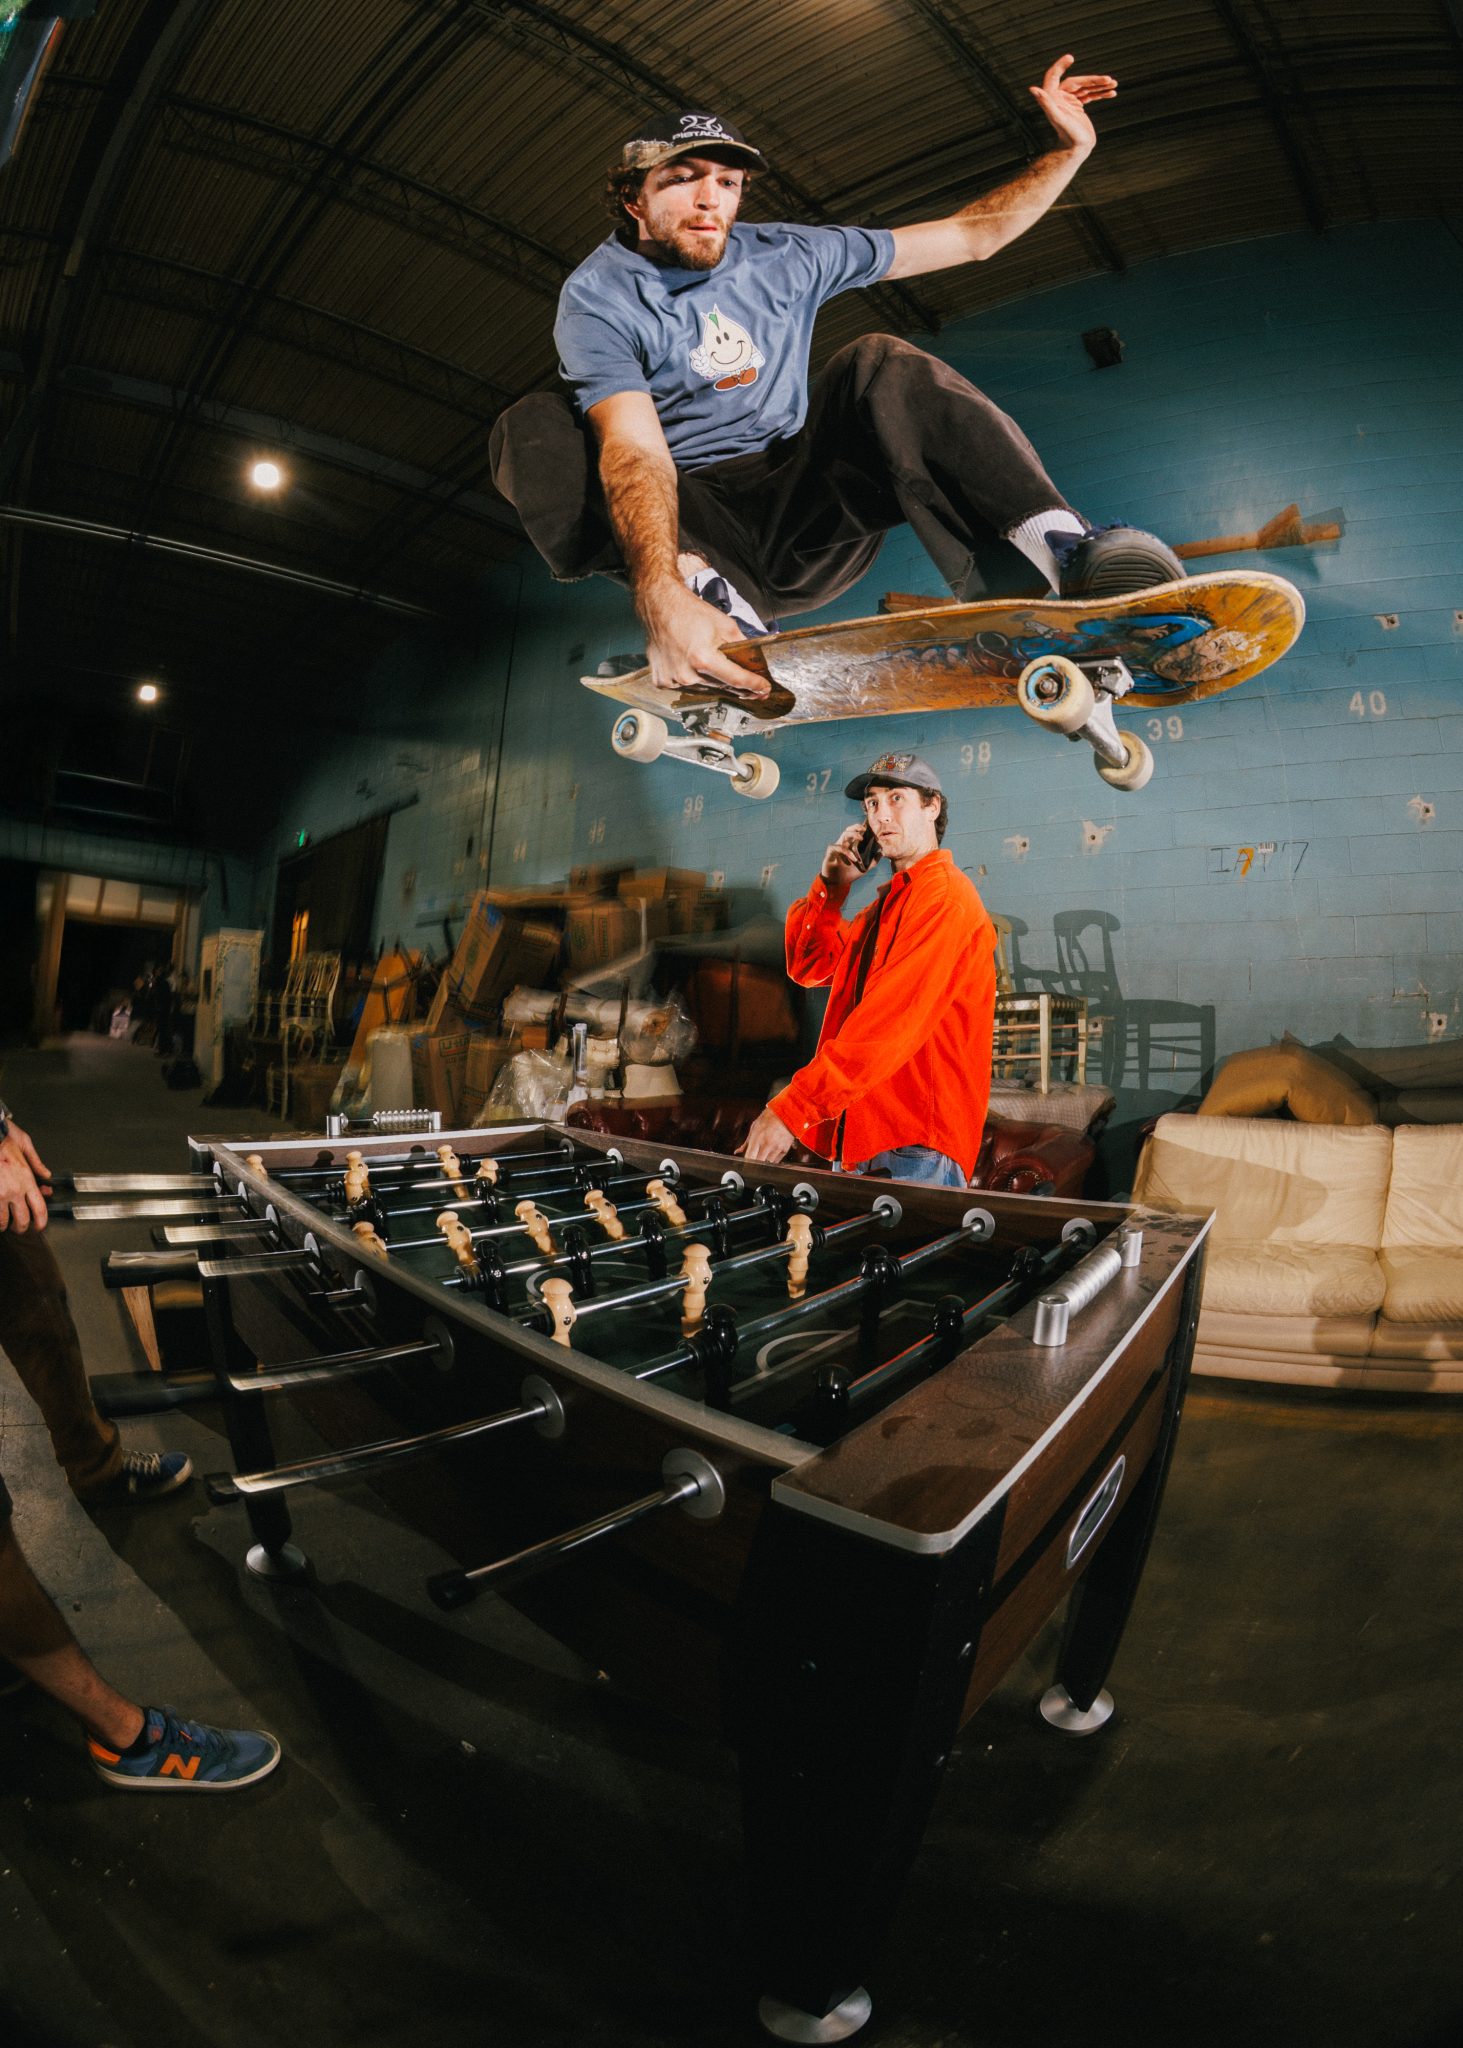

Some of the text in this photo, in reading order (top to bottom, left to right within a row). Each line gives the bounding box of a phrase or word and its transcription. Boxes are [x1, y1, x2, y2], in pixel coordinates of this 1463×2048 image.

[1349, 691, 1388, 717] 40
[1146, 715, 1185, 742] 39
[960, 741, 991, 766] 38
[806, 768, 832, 791] 37
[159, 1753, 201, 1780] N
